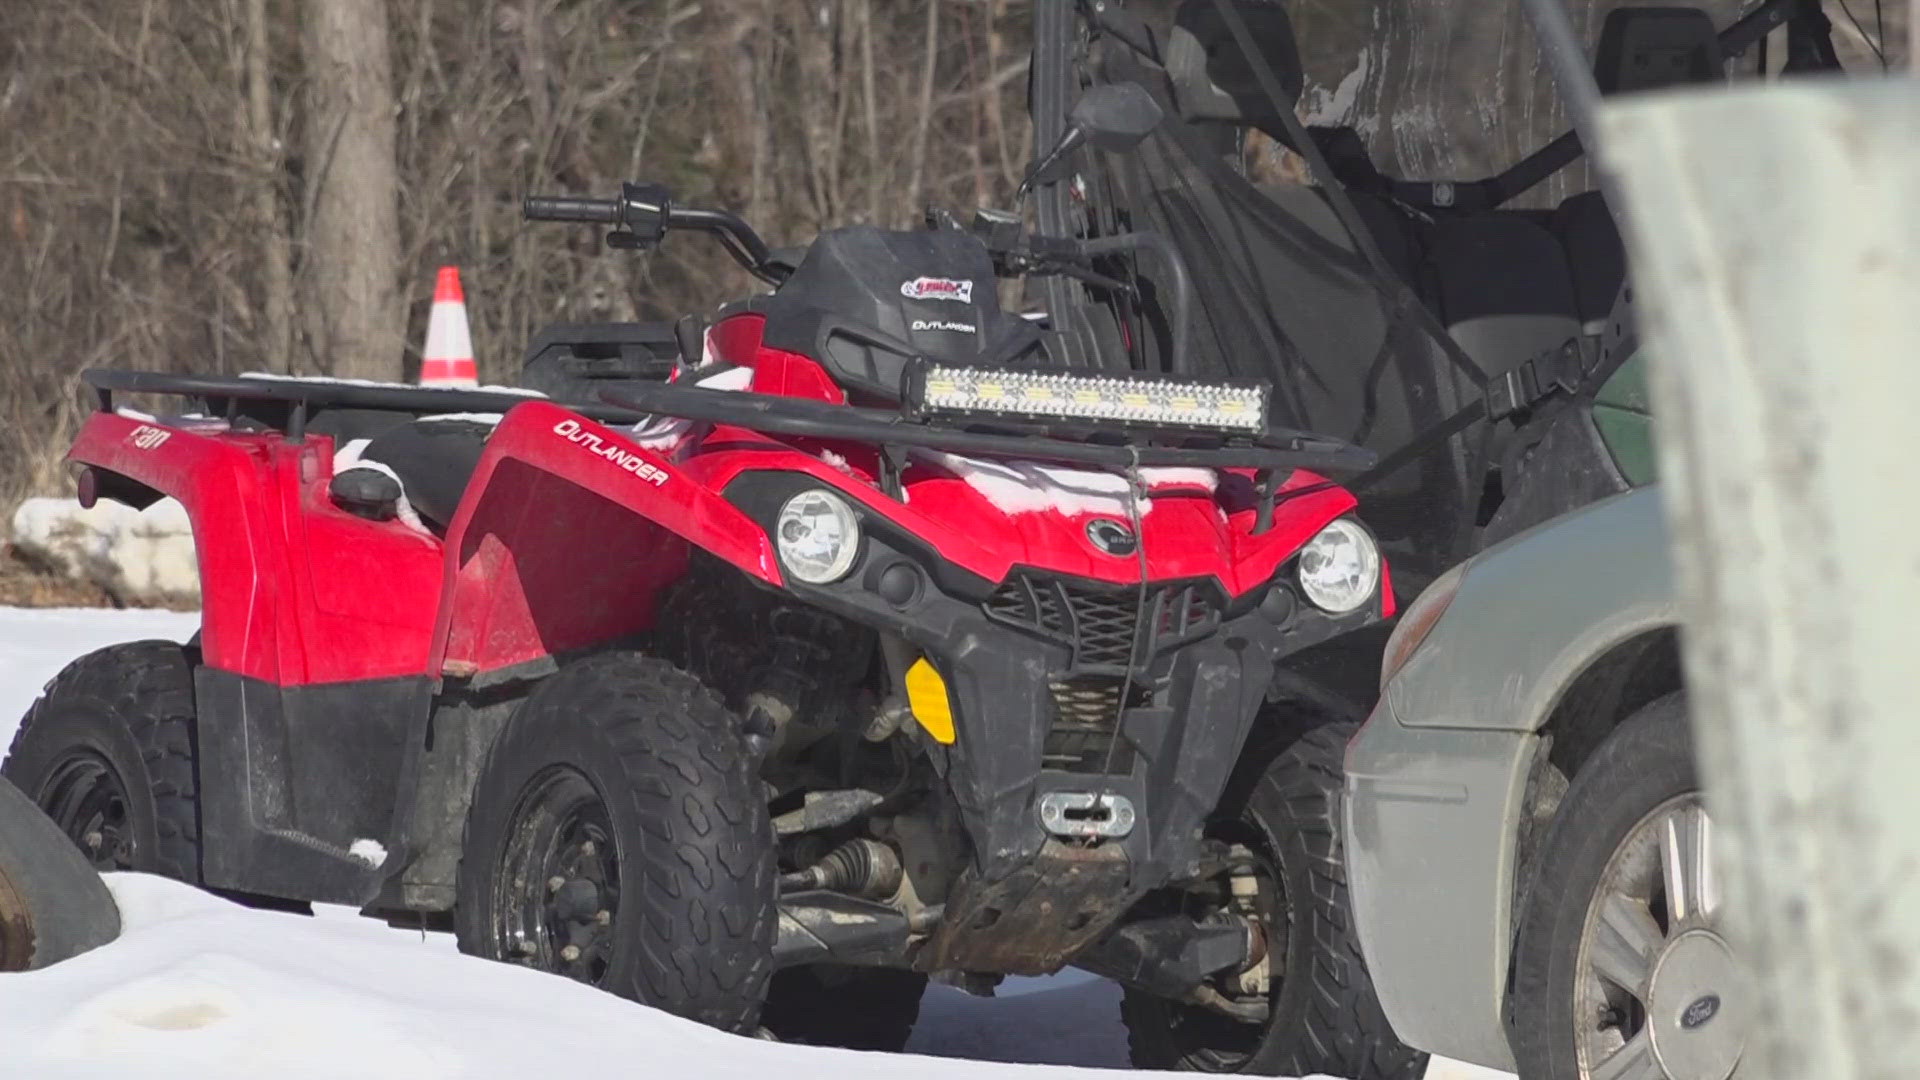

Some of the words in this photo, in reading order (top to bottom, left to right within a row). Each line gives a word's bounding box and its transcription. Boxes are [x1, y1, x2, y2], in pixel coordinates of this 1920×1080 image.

[912, 321, 976, 334] OUTLANDER
[553, 419, 669, 486] OUTLANDER
[1688, 1000, 1712, 1026] Ford
